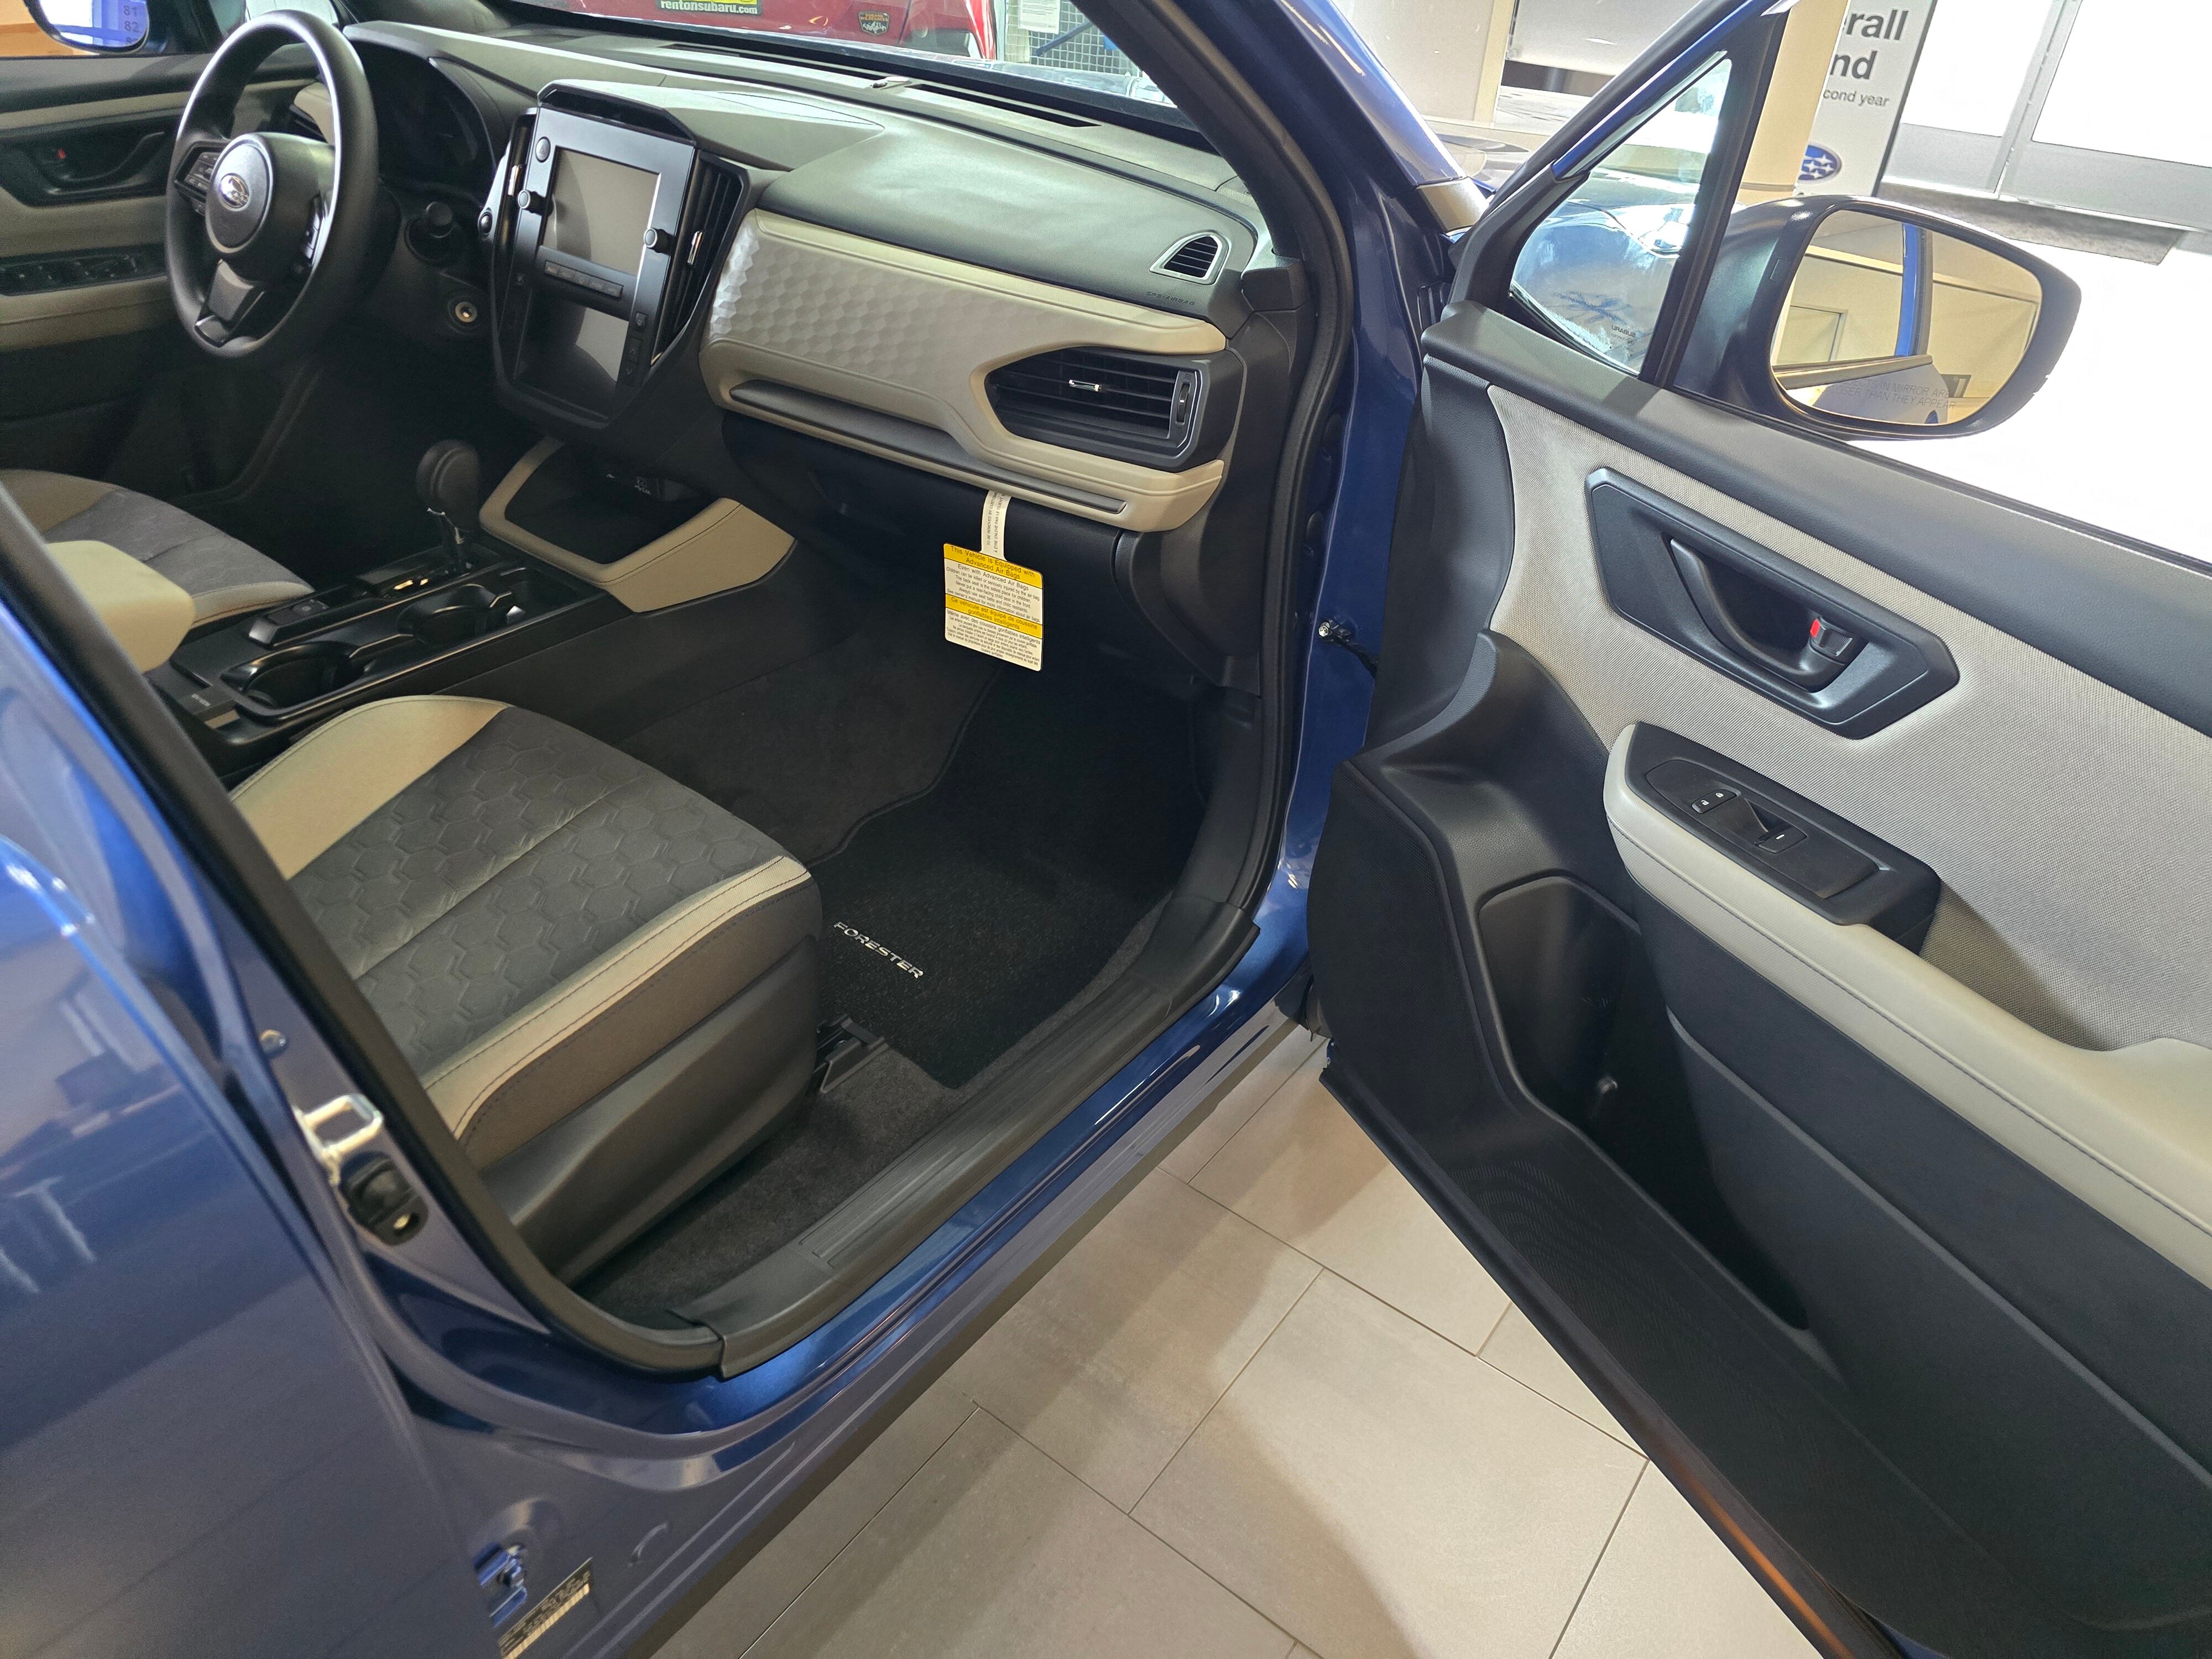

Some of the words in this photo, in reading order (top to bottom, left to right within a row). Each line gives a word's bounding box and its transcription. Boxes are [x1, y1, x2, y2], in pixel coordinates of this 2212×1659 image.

[661, 1, 758, 14] rentonsubaru.com
[124, 20, 140, 33] 82
[1844, 9, 1909, 40] rall
[1858, 92, 1890, 107] year
[1892, 393, 1917, 404] THEY
[1917, 397, 1957, 409] APPEAR
[951, 546, 962, 554] This
[965, 550, 985, 561] Vehicle
[995, 560, 1021, 573] Equipped
[1024, 569, 1035, 577] with
[966, 557, 993, 571] Advanced
[1006, 570, 1021, 580] Bags
[983, 572, 1006, 583] Advanced
[1017, 582, 1029, 591] Bags
[833, 921, 924, 978] FORESTER
